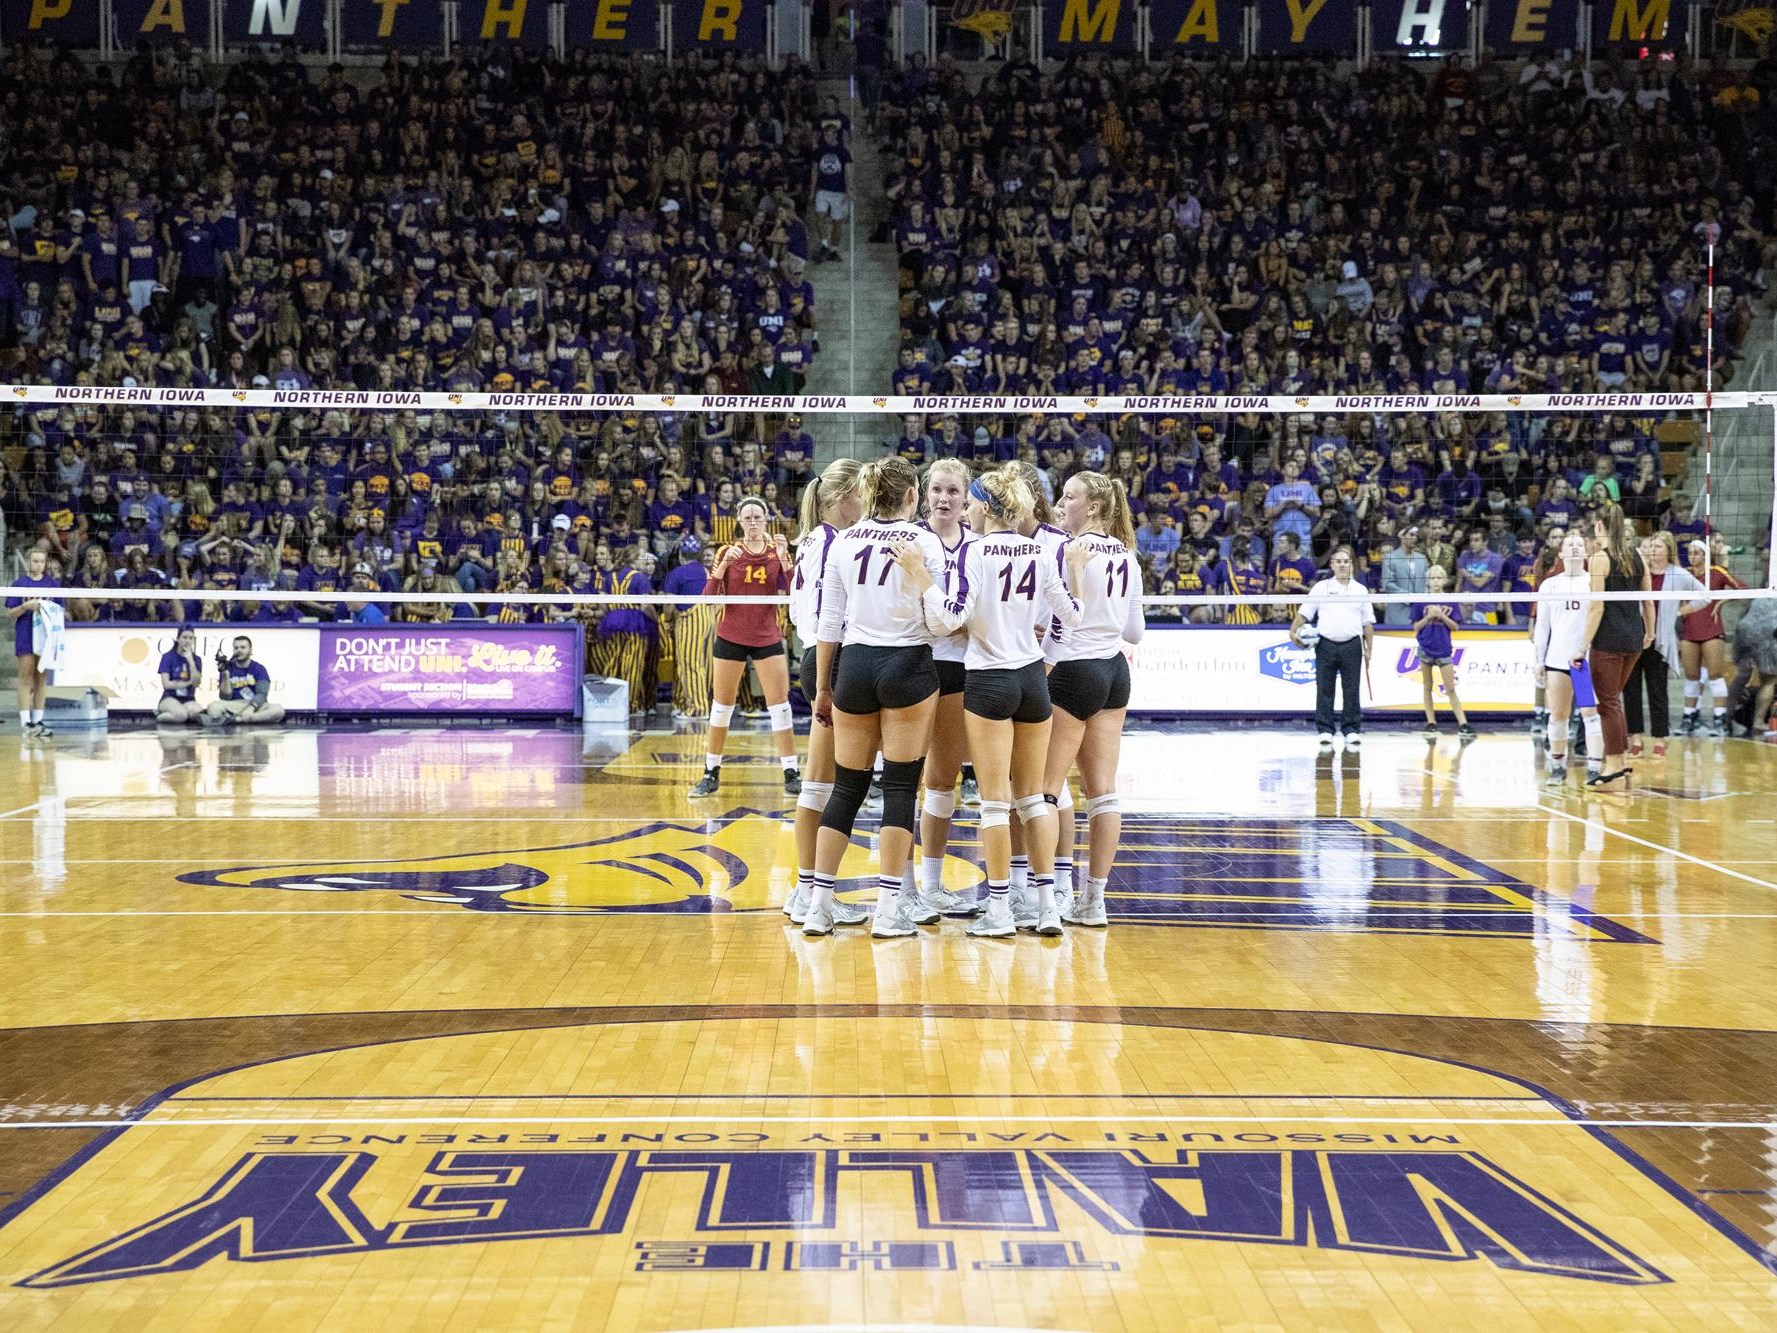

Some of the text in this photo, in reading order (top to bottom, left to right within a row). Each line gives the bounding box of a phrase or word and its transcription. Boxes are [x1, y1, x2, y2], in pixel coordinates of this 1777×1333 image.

[55, 388, 205, 401] NORTHERN IOWA
[273, 391, 421, 404] NORTHERN IOWA
[488, 394, 635, 406] NORTHERN IOWA
[1547, 394, 1694, 406] NORTHERN IOWA
[701, 396, 846, 408] NORTHERN IOWA
[913, 397, 1058, 408] NORTHERN IOWA
[1123, 397, 1269, 408] NORTHERN IOWA
[1335, 396, 1481, 407] NORTHERN IOWA
[983, 544, 1041, 556] PANTHERS
[854, 545, 899, 586] 17
[744, 565, 767, 584] 14
[998, 560, 1036, 602] 14
[1105, 559, 1128, 597] 11
[335, 638, 450, 656] DON'T JUST
[333, 656, 416, 672] ATTEND
[1468, 662, 1534, 674] PANTH
[254, 1132, 1461, 1145] MISSOURI VALLEY CONFERENCE
[14, 1150, 1674, 1287] VALLEY
[635, 1241, 1121, 1271] THE
